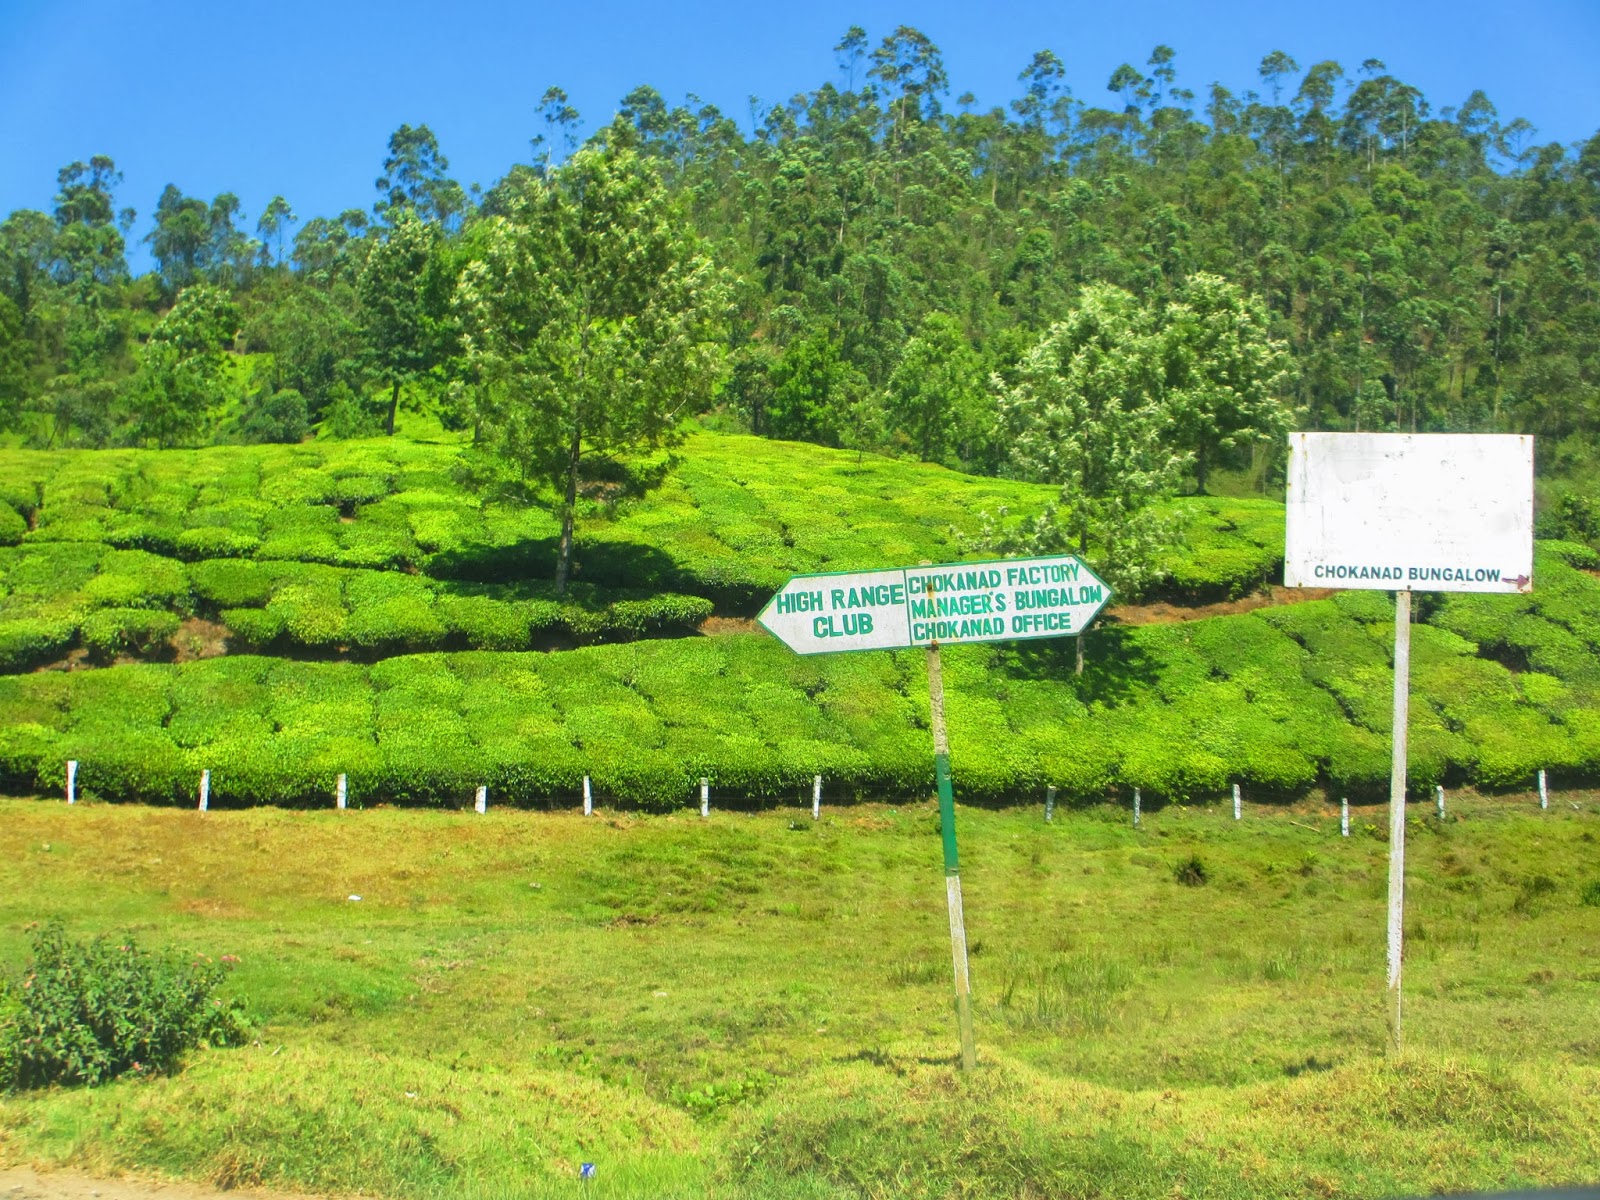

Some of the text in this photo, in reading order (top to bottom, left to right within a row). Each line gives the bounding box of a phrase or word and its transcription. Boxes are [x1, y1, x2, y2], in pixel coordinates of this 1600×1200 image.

[908, 563, 1080, 595] CHOKANAD FACTORY
[1314, 565, 1501, 582] CHOKANAD BUNGALOW
[776, 584, 905, 614] HIGH RANGE
[911, 585, 1102, 619] MANAGER'S BUNGALOW
[813, 613, 874, 639] CLUB
[913, 612, 1072, 641] CHOKANAD OFFICE
